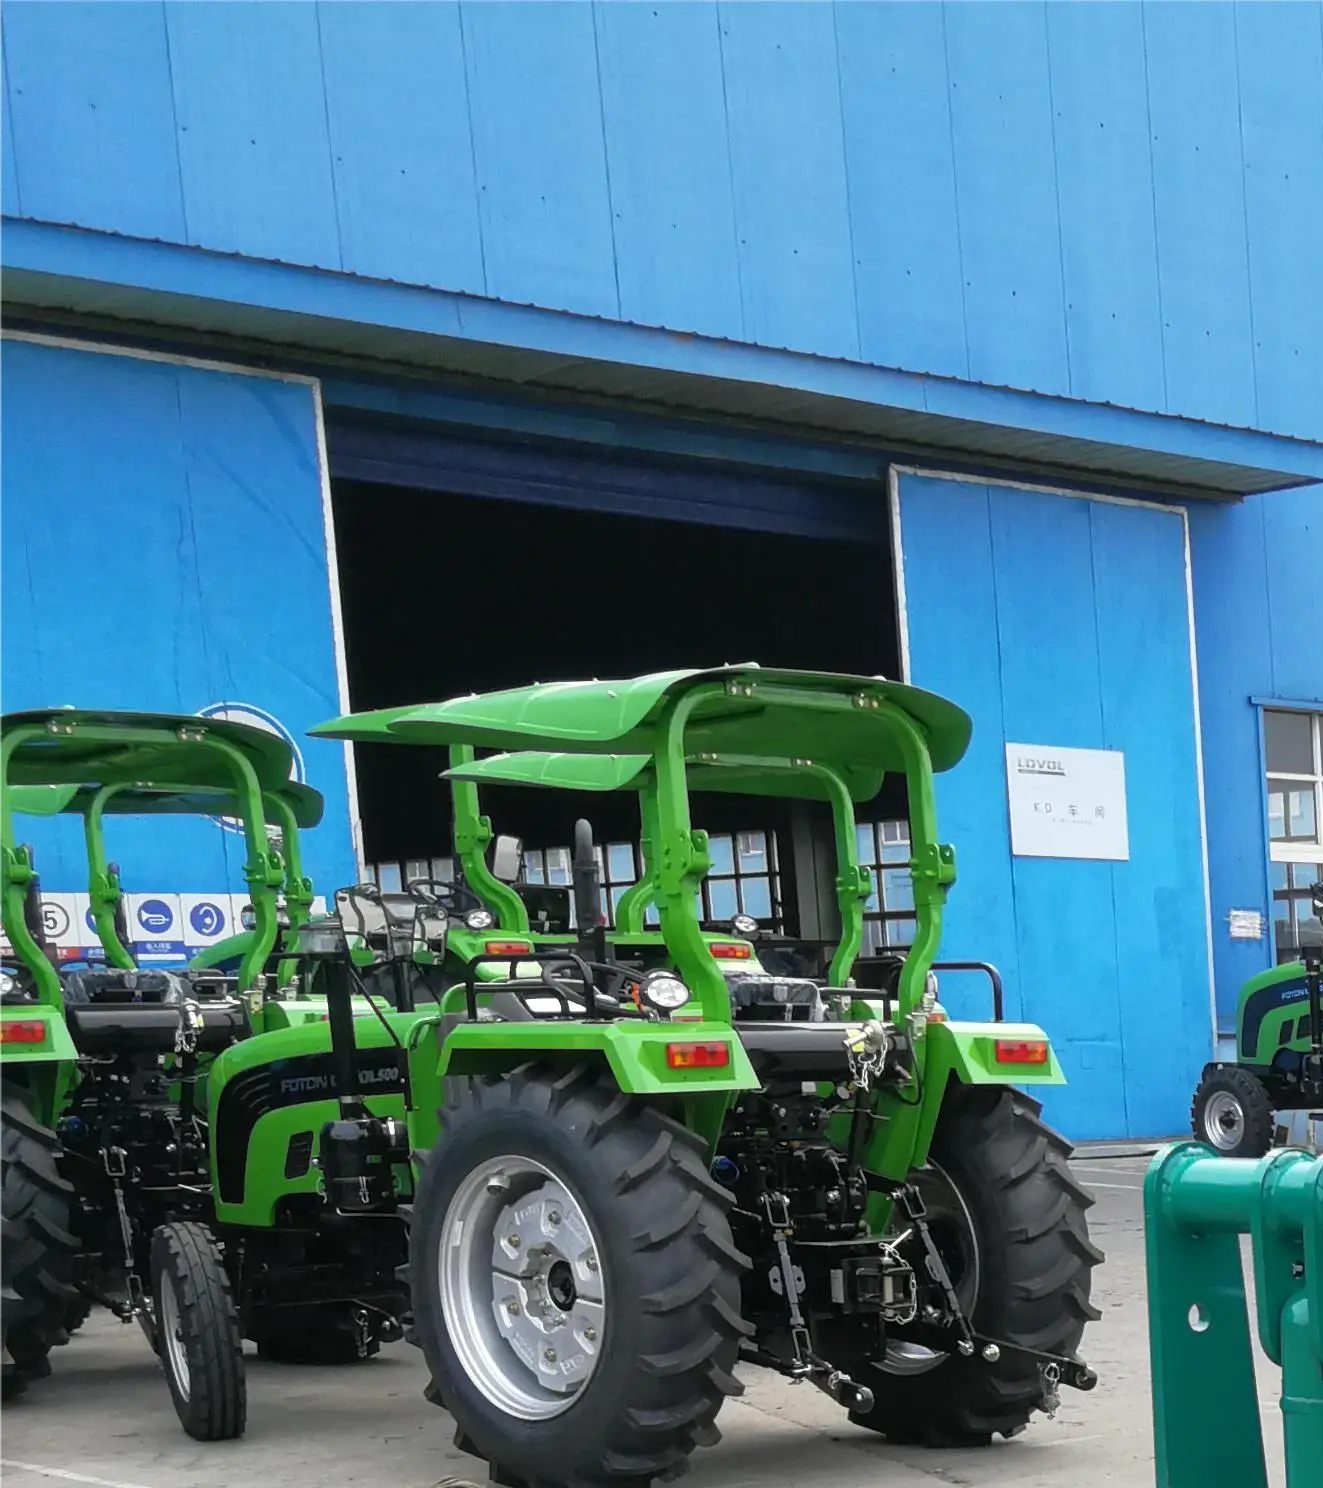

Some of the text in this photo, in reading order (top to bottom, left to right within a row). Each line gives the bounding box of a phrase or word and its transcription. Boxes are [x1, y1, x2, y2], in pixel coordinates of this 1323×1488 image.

[1018, 758, 1065, 771] LOVOL
[44, 910, 57, 930] 5
[281, 1075, 328, 1093] FOTON
